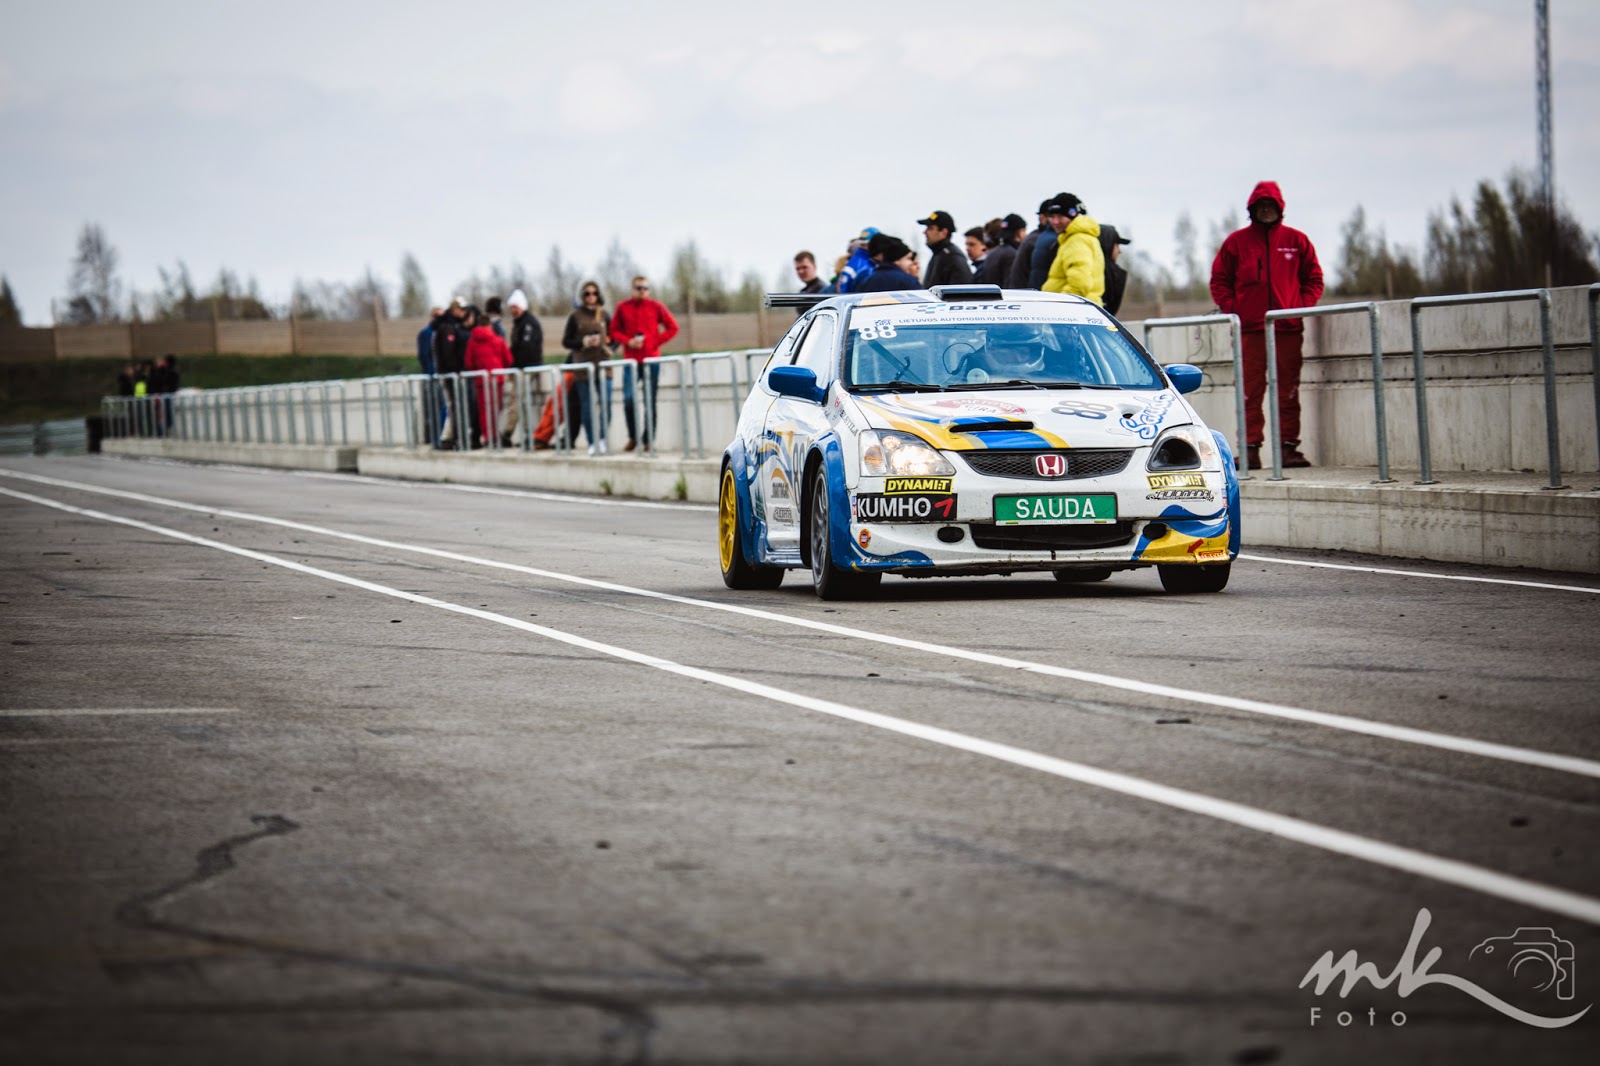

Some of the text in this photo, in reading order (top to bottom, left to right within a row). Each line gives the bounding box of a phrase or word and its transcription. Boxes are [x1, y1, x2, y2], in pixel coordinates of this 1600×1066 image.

[858, 324, 897, 340] 88
[1051, 400, 1114, 420] 88
[857, 497, 932, 518] KUMHO
[1015, 498, 1096, 518] SAUDA
